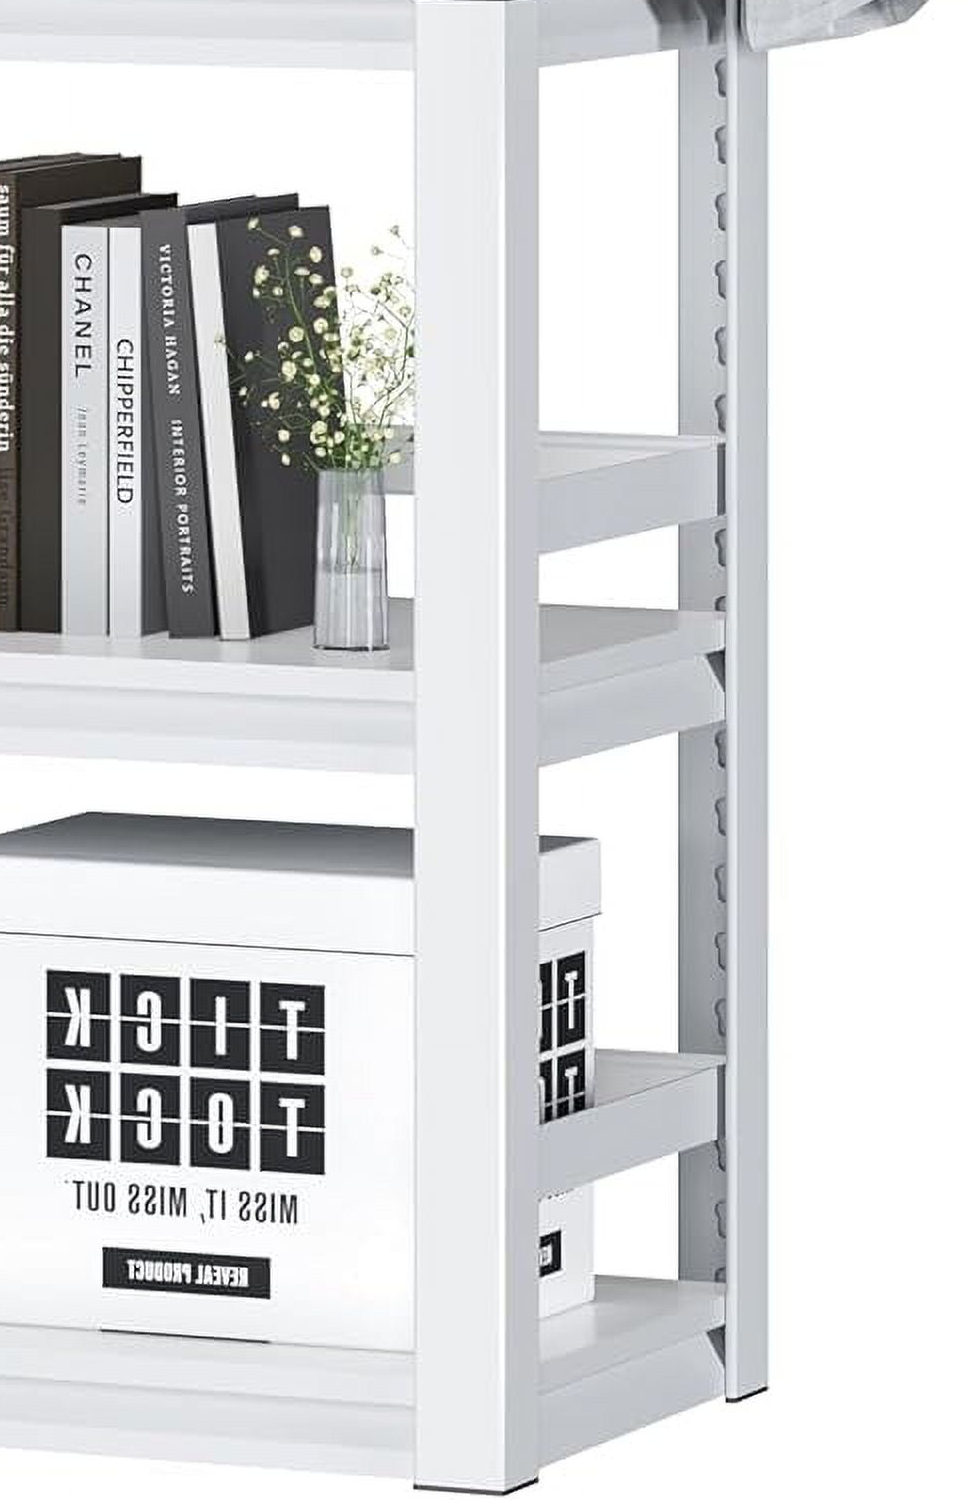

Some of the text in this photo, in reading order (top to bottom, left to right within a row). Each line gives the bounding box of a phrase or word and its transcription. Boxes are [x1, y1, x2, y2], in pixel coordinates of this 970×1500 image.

[73, 252, 93, 378] CHANEL
[159, 243, 181, 396] VICTORIA HAGAN
[115, 338, 135, 505] CHIPPERFIELD
[170, 418, 194, 595] INTERIOR PORTRAITS
